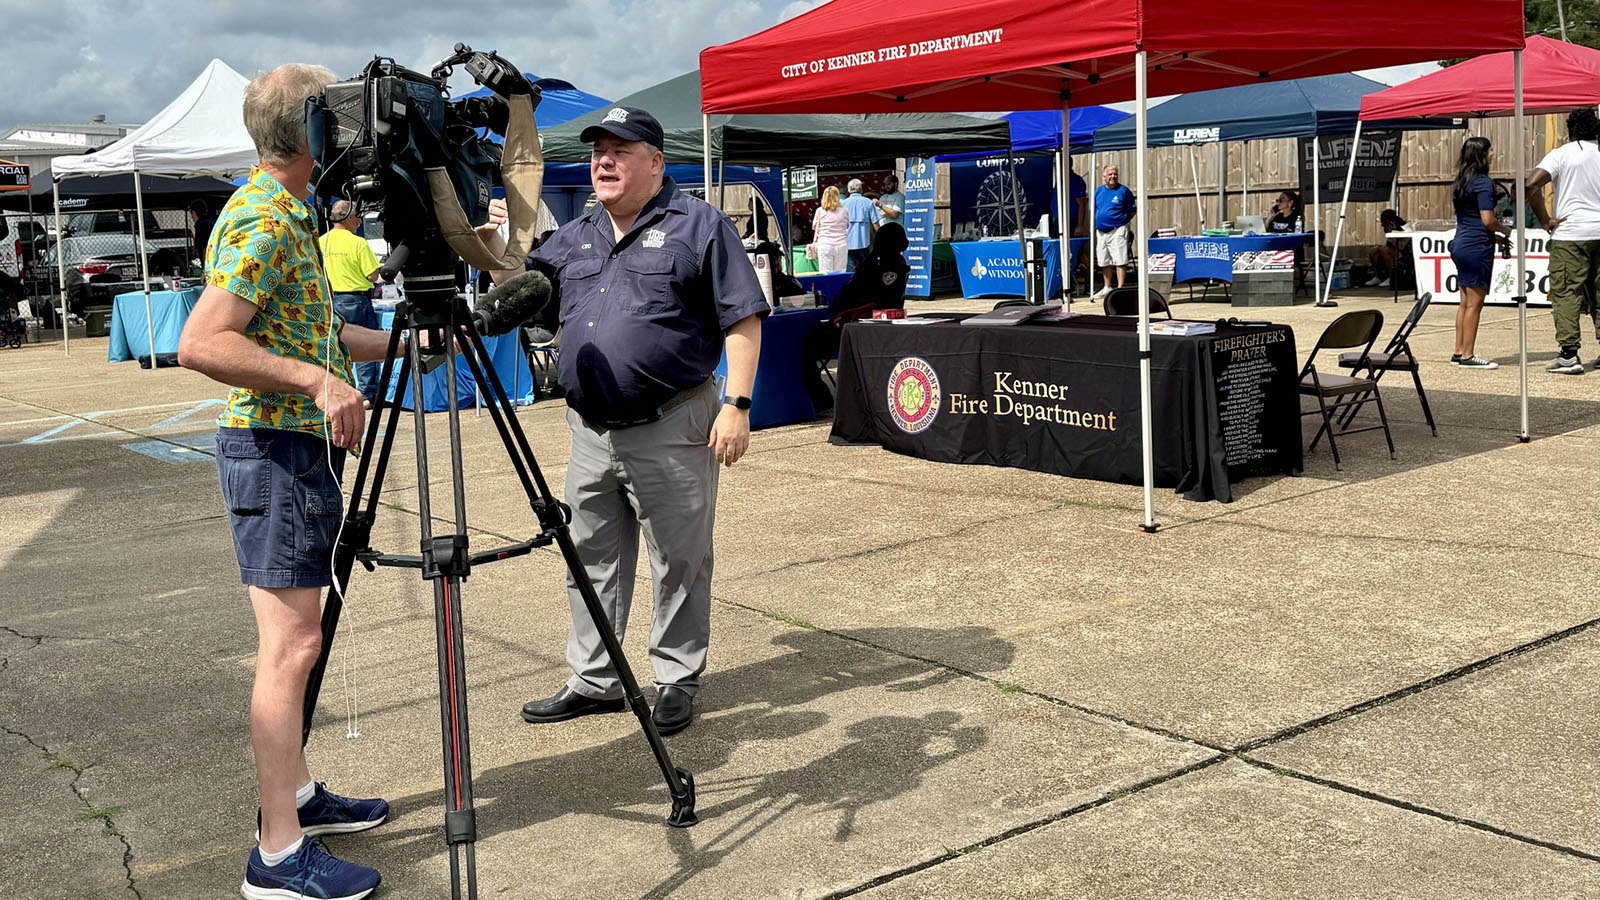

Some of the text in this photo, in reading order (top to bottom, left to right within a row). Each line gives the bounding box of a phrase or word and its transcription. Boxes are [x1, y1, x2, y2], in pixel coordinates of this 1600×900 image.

[781, 28, 1003, 78] CITY OF KENNER FIRE DEPARTMENT
[1174, 127, 1220, 139] DUFRENE
[1304, 138, 1397, 161] DUFRENE
[781, 168, 816, 186] FRTIFIED
[54, 197, 89, 207] cademy
[1183, 241, 1229, 254] DUFRENE
[1213, 330, 1286, 353] FIREFIGHTER'S
[1230, 345, 1267, 362] PRAYER
[889, 359, 939, 390] FIRE DEPARTMENT
[993, 371, 1069, 401] Kenner
[910, 406, 938, 432] LOUISIANA
[949, 393, 989, 415] Fire
[993, 394, 1118, 432] Department
